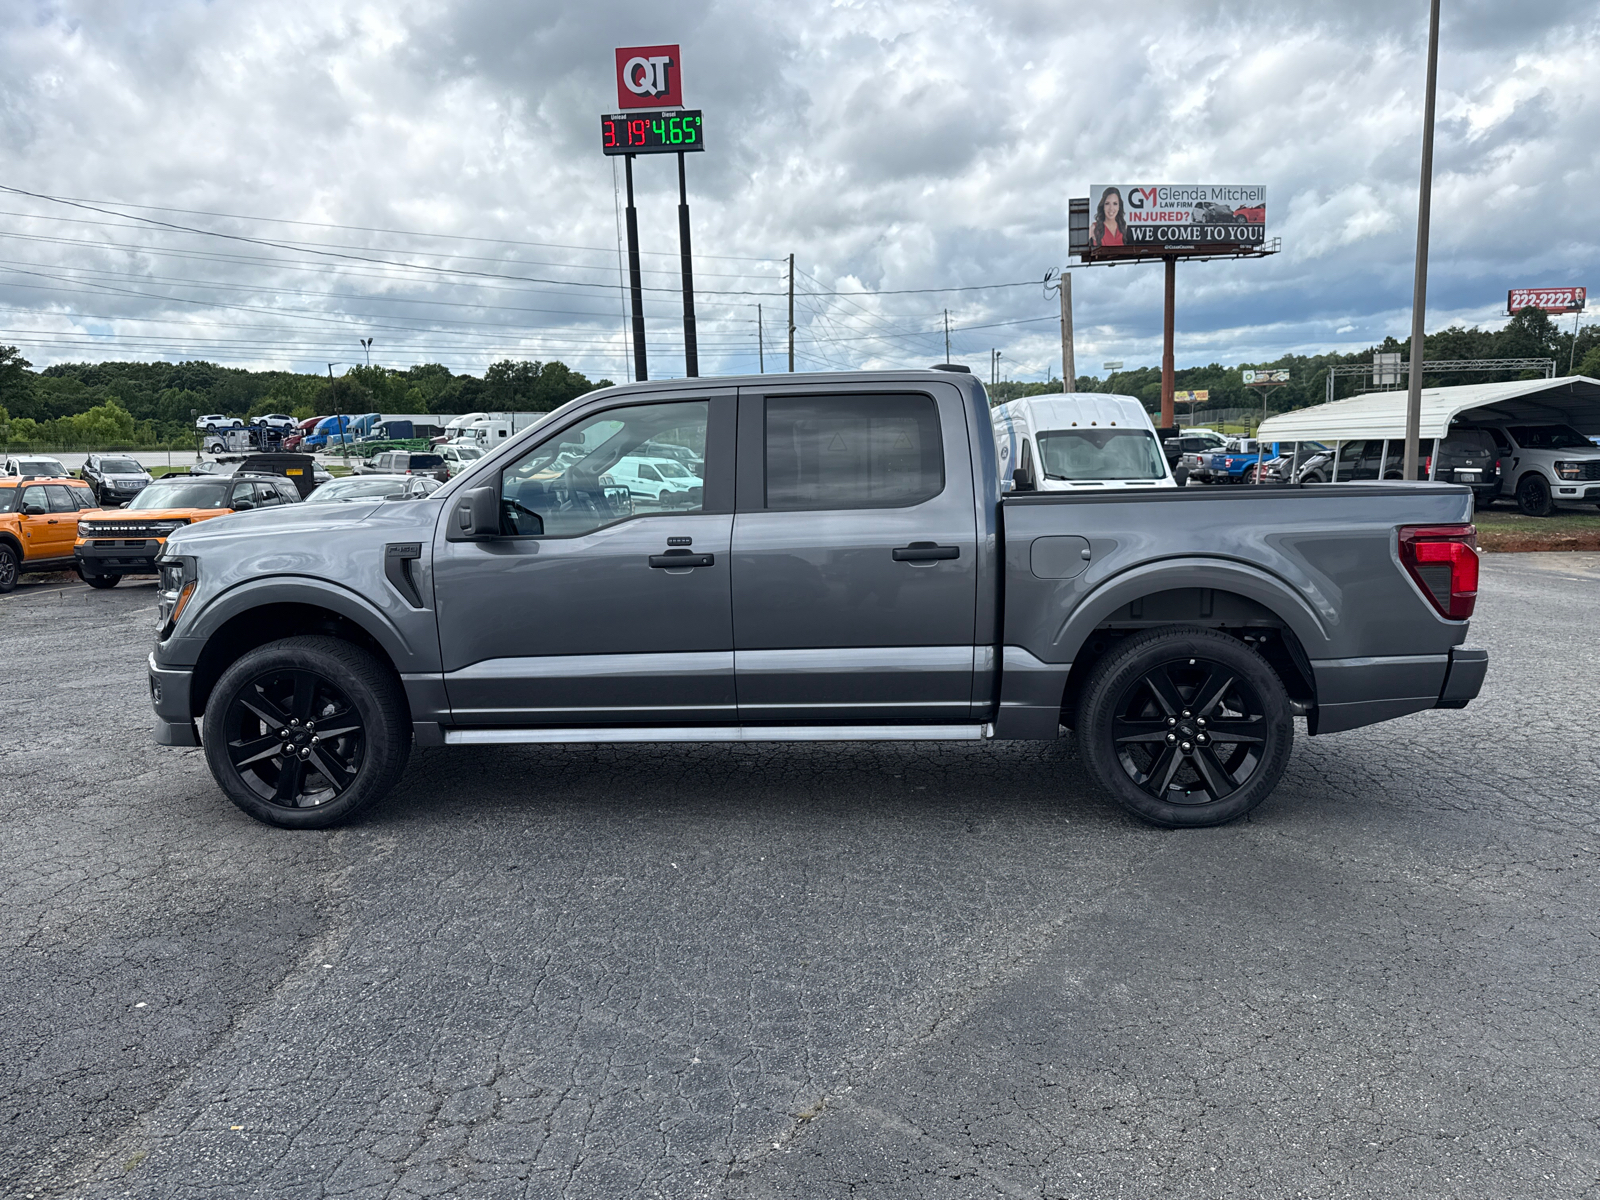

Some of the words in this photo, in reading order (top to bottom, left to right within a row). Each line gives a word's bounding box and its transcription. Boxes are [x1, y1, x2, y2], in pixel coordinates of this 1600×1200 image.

[623, 56, 670, 96] QT
[1128, 187, 1157, 209] GM
[1158, 187, 1207, 201] Glenda
[1211, 187, 1264, 201] Mitchell
[1129, 211, 1190, 222] INJURED?
[1131, 226, 1154, 241] WE
[1157, 226, 1201, 241] COME
[1204, 226, 1225, 241] TO
[1229, 226, 1264, 241] YOU!
